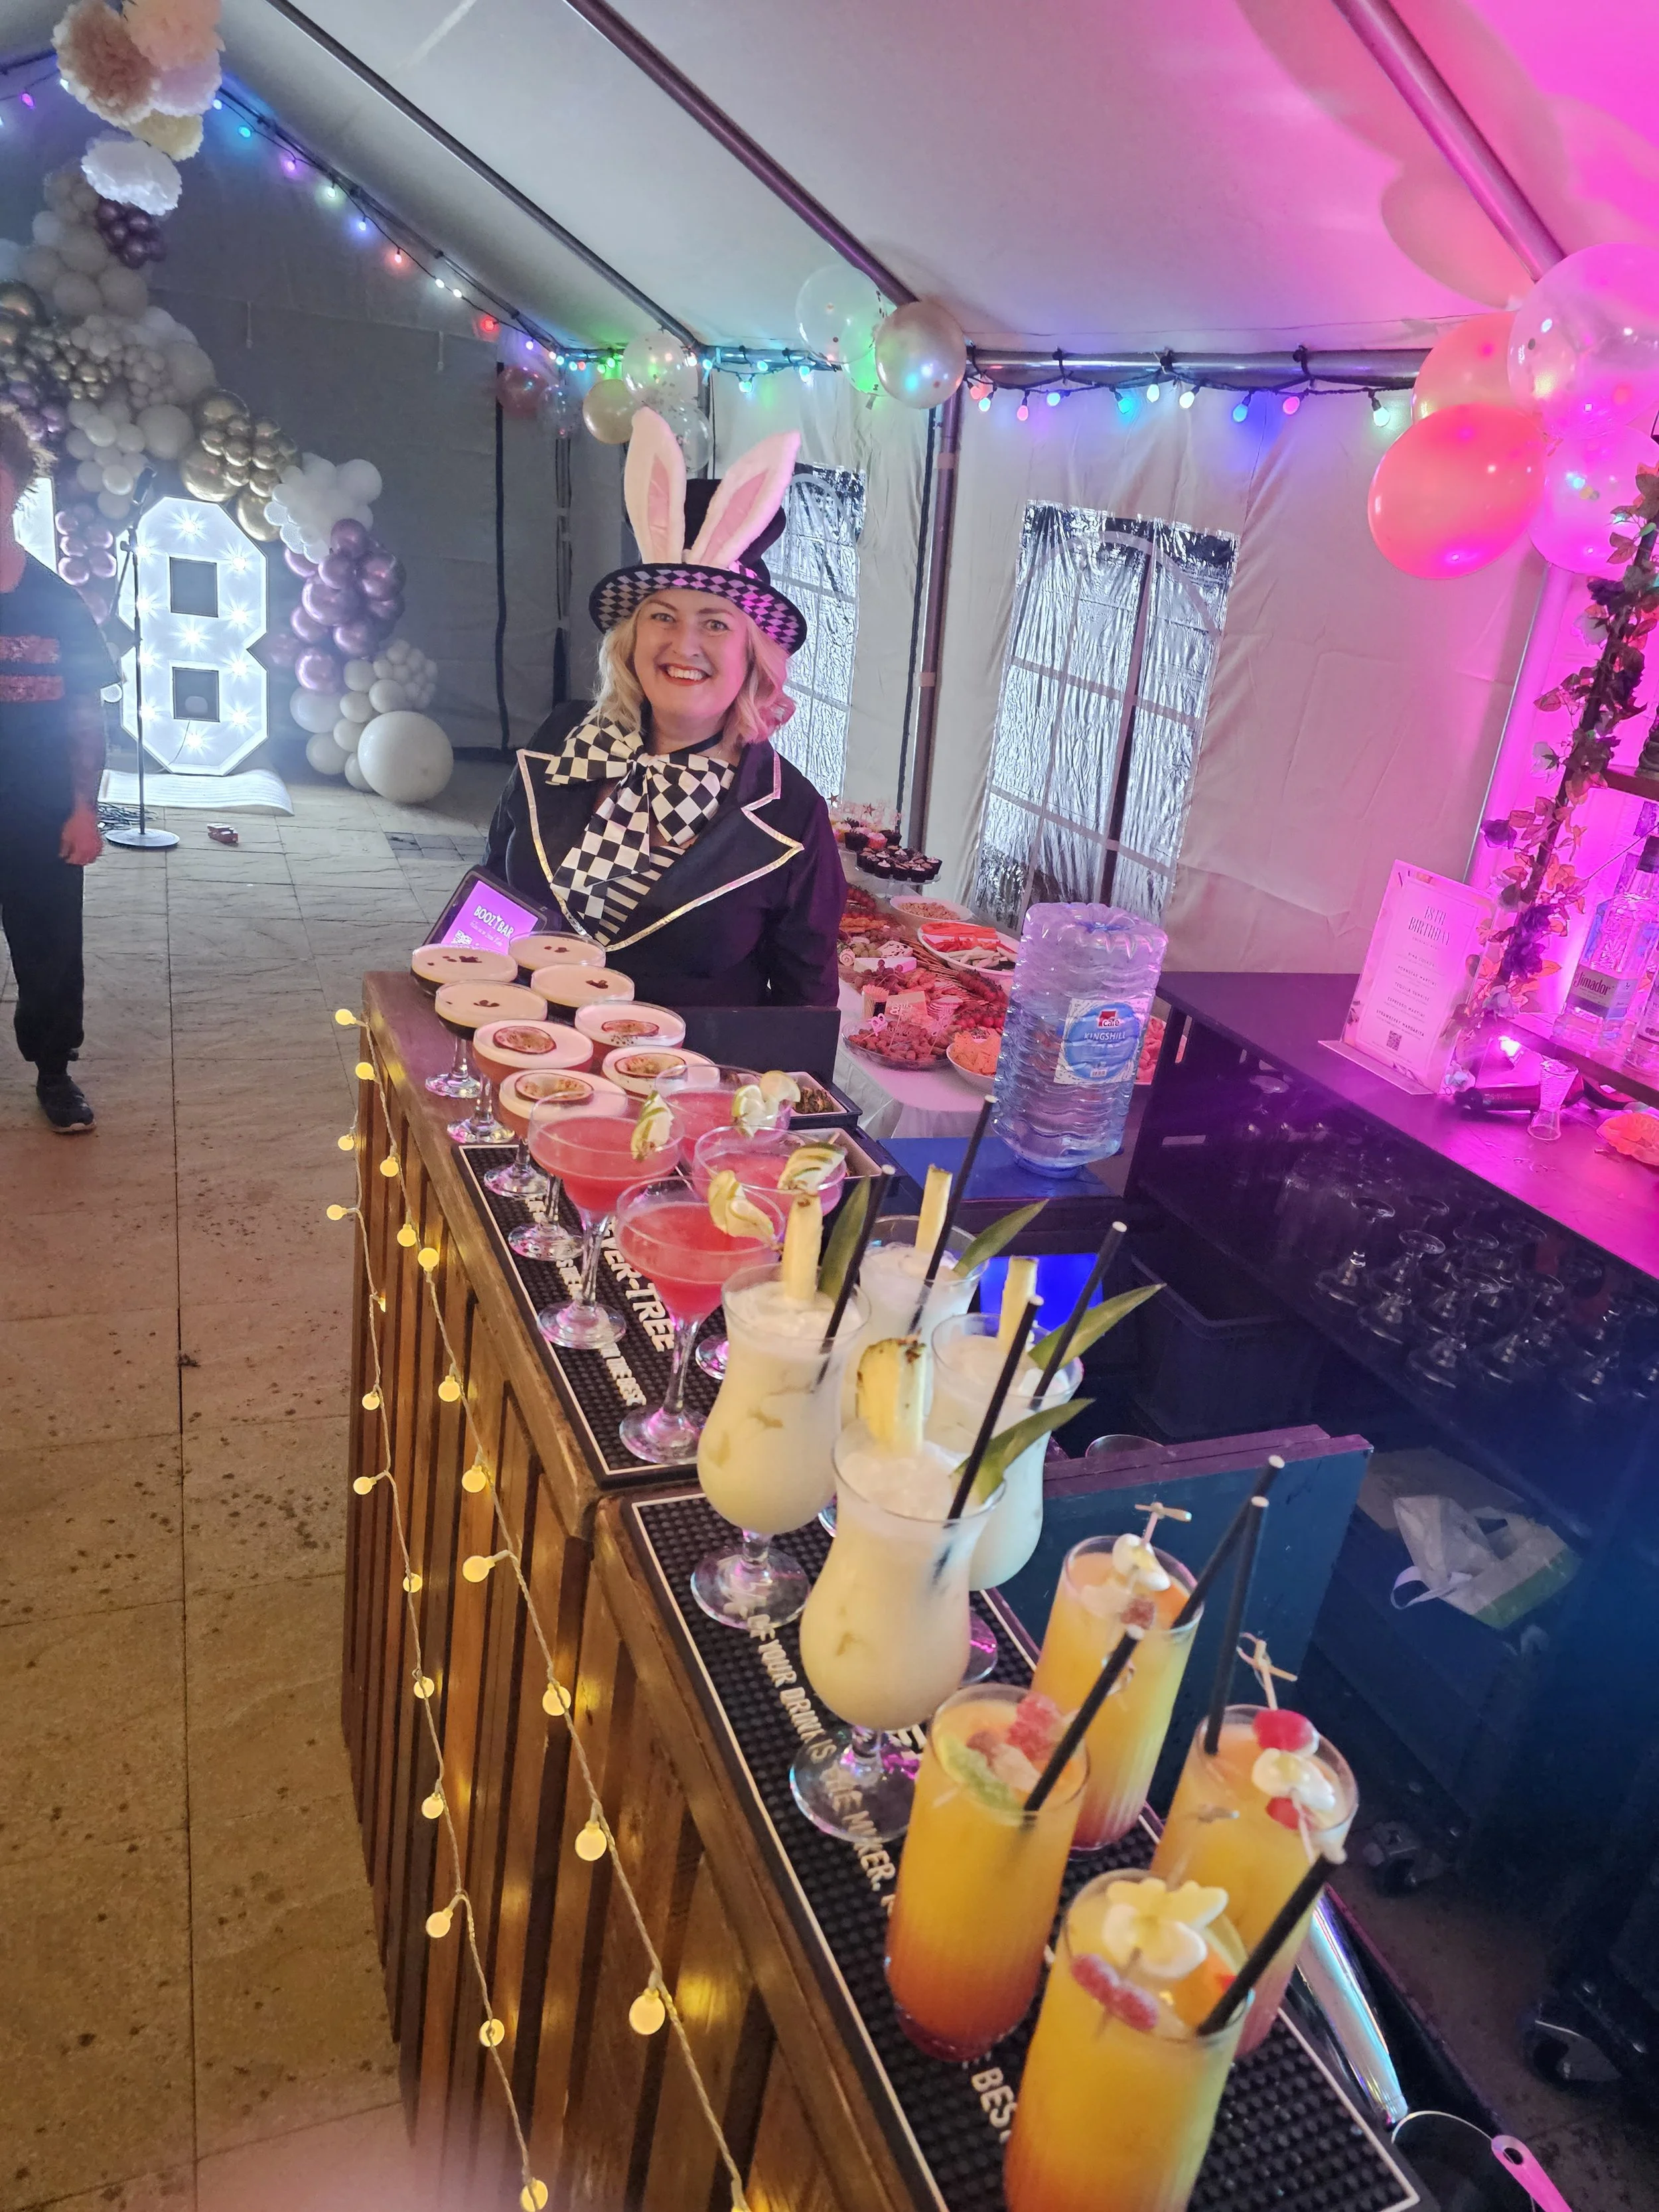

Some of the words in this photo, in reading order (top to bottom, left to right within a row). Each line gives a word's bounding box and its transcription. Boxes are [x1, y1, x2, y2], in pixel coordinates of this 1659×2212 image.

[473, 905, 504, 930] BOOZY
[497, 921, 514, 938] BAR
[1408, 917, 1450, 946] BIRTHDAY
[1083, 1031, 1127, 1041] KINGSHILL
[600, 1216, 675, 1353] EVER-TREE
[758, 1639, 797, 1688] YOUR
[780, 1686, 826, 1744] DRINK
